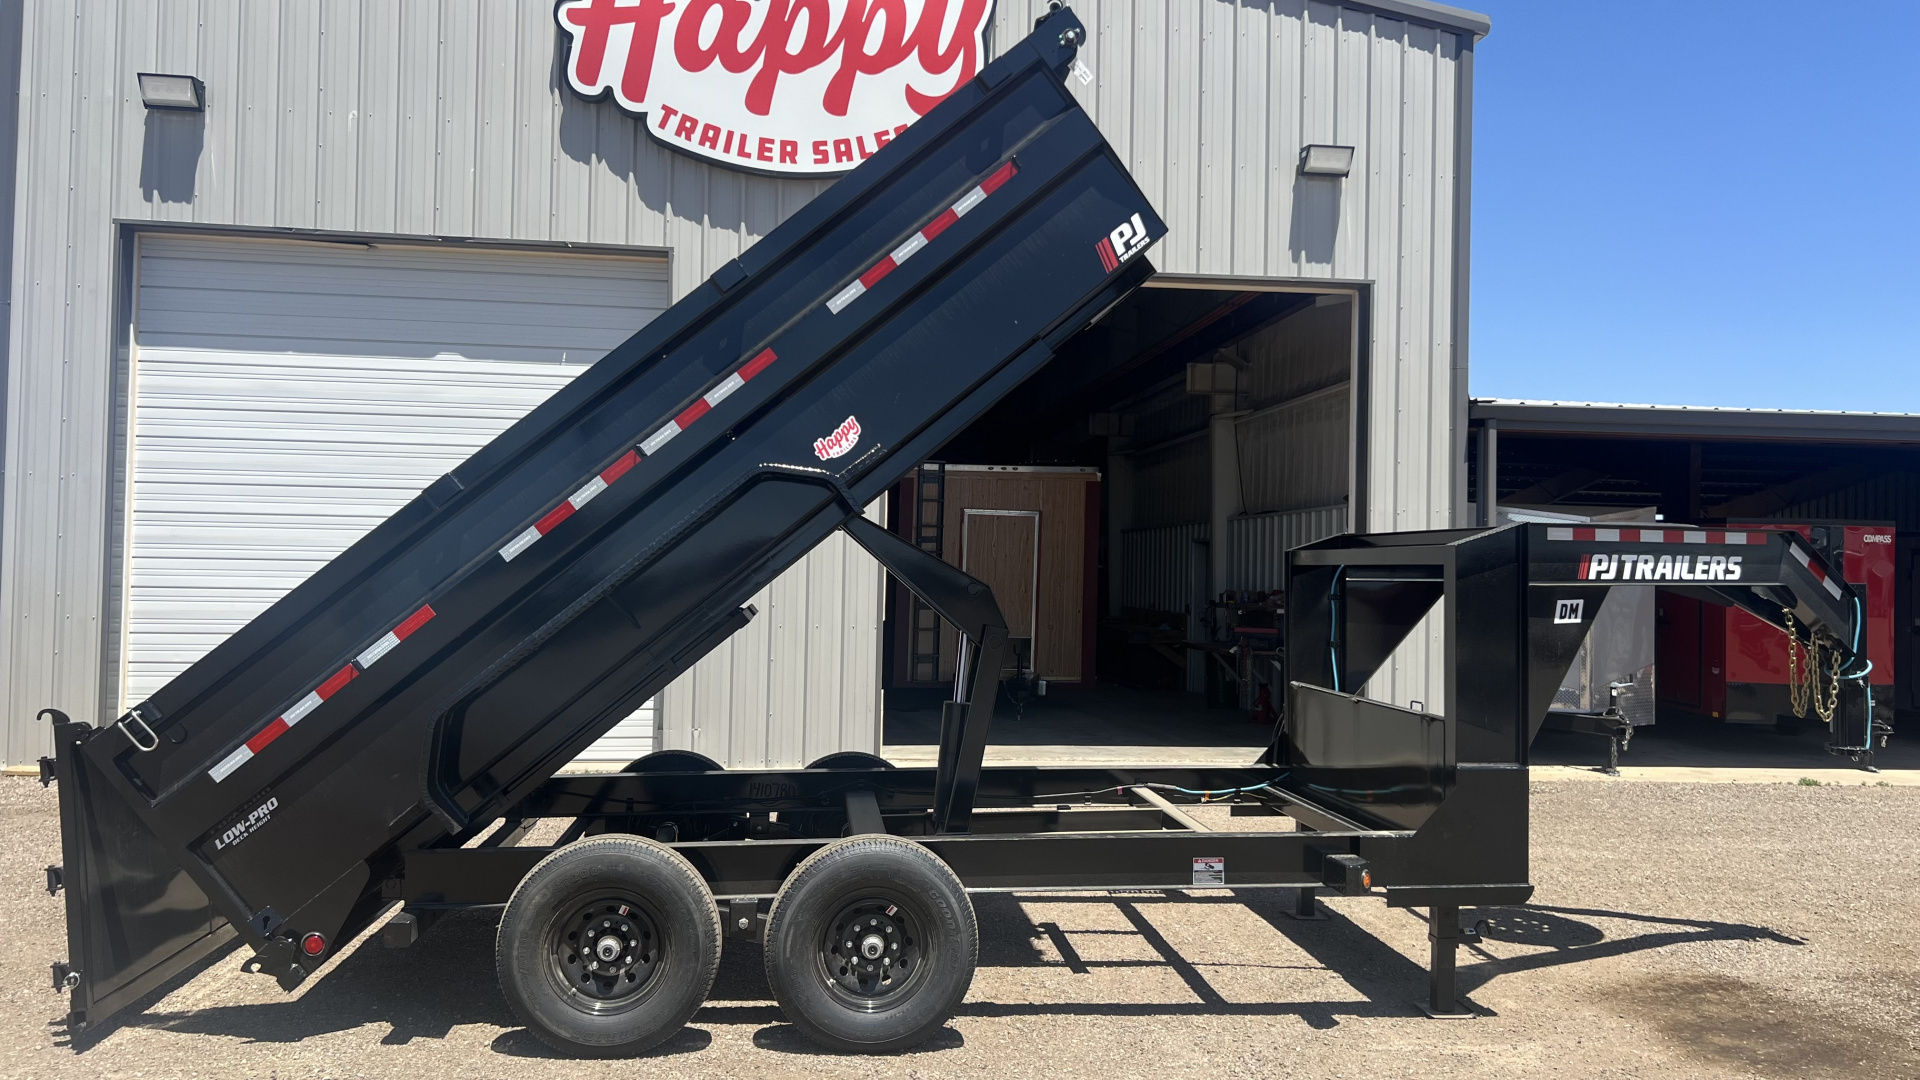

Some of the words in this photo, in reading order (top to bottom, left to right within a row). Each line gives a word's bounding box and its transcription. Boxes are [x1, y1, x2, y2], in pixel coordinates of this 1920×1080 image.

[658, 103, 798, 165] TRAILER
[1110, 212, 1147, 257] PJ
[1118, 236, 1151, 263] TRAILERS
[815, 417, 860, 460] Happy
[1863, 533, 1892, 544] COMPASS
[1588, 554, 1619, 580] PJ
[1620, 554, 1742, 581] TRAILERS
[1558, 602, 1580, 620] DM
[214, 796, 279, 851] LOW-PRO
[232, 832, 249, 846] DECK
[248, 814, 272, 834] HEIGHT
